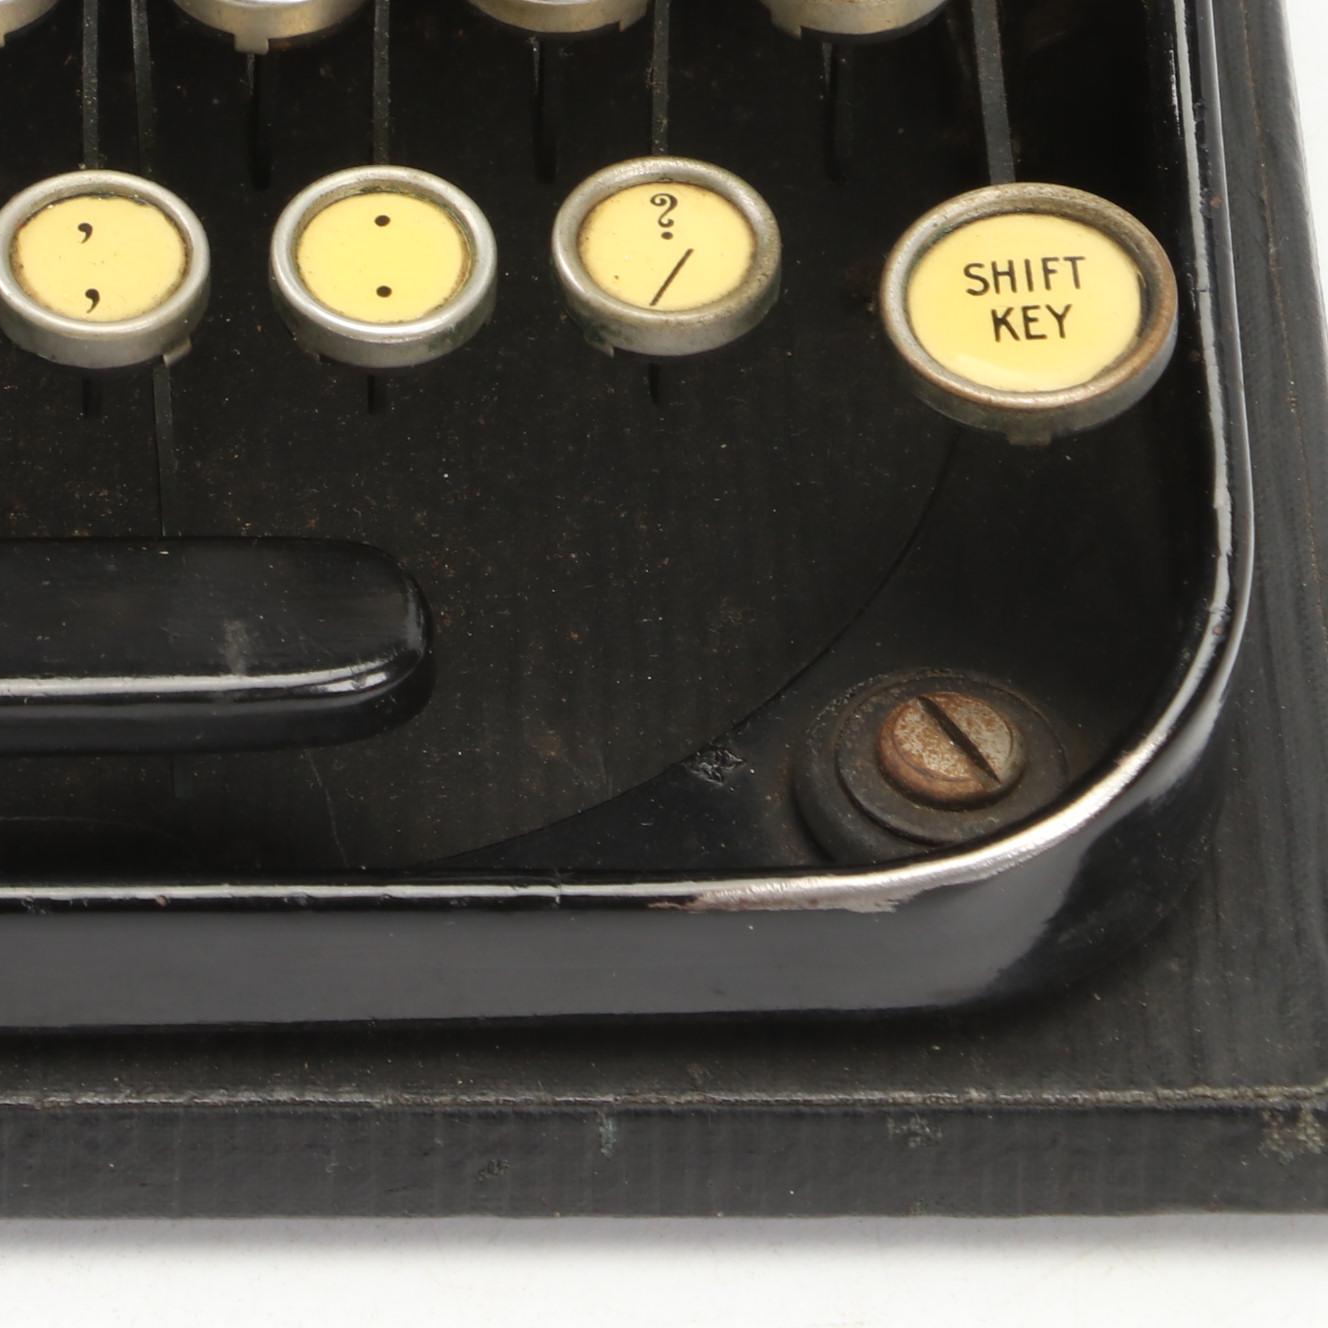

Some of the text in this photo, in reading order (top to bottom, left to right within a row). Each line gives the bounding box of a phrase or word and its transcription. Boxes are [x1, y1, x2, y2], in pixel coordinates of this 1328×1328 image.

[649, 192, 679, 241] ?
[962, 256, 1086, 297] SHIFT
[991, 305, 1072, 343] KEY
